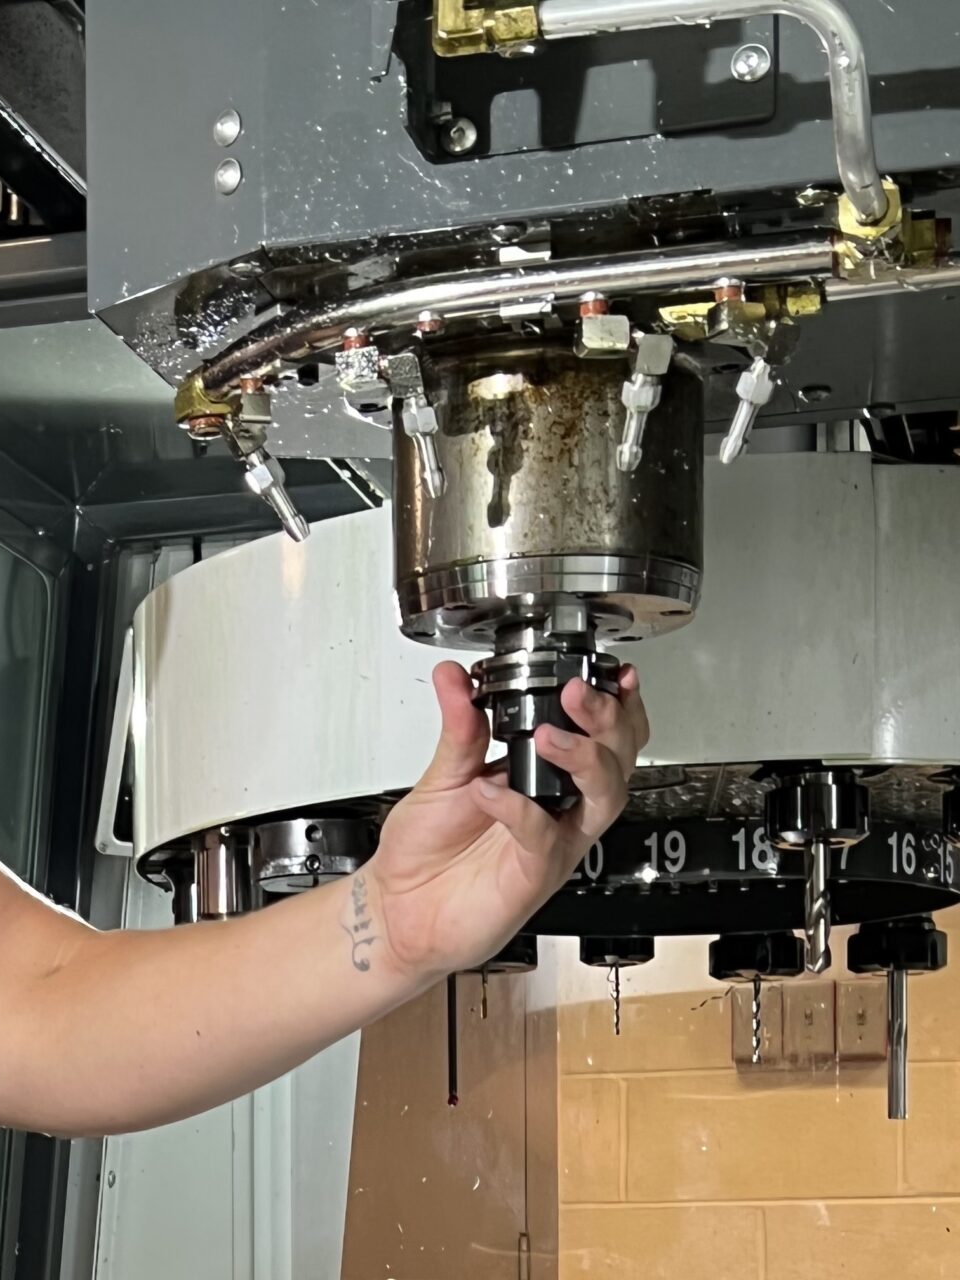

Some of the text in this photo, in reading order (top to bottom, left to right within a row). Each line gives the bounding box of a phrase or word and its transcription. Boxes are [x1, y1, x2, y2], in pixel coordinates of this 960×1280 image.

[644, 830, 686, 874] 19
[732, 827, 777, 871] 18
[888, 831, 916, 875] 16
